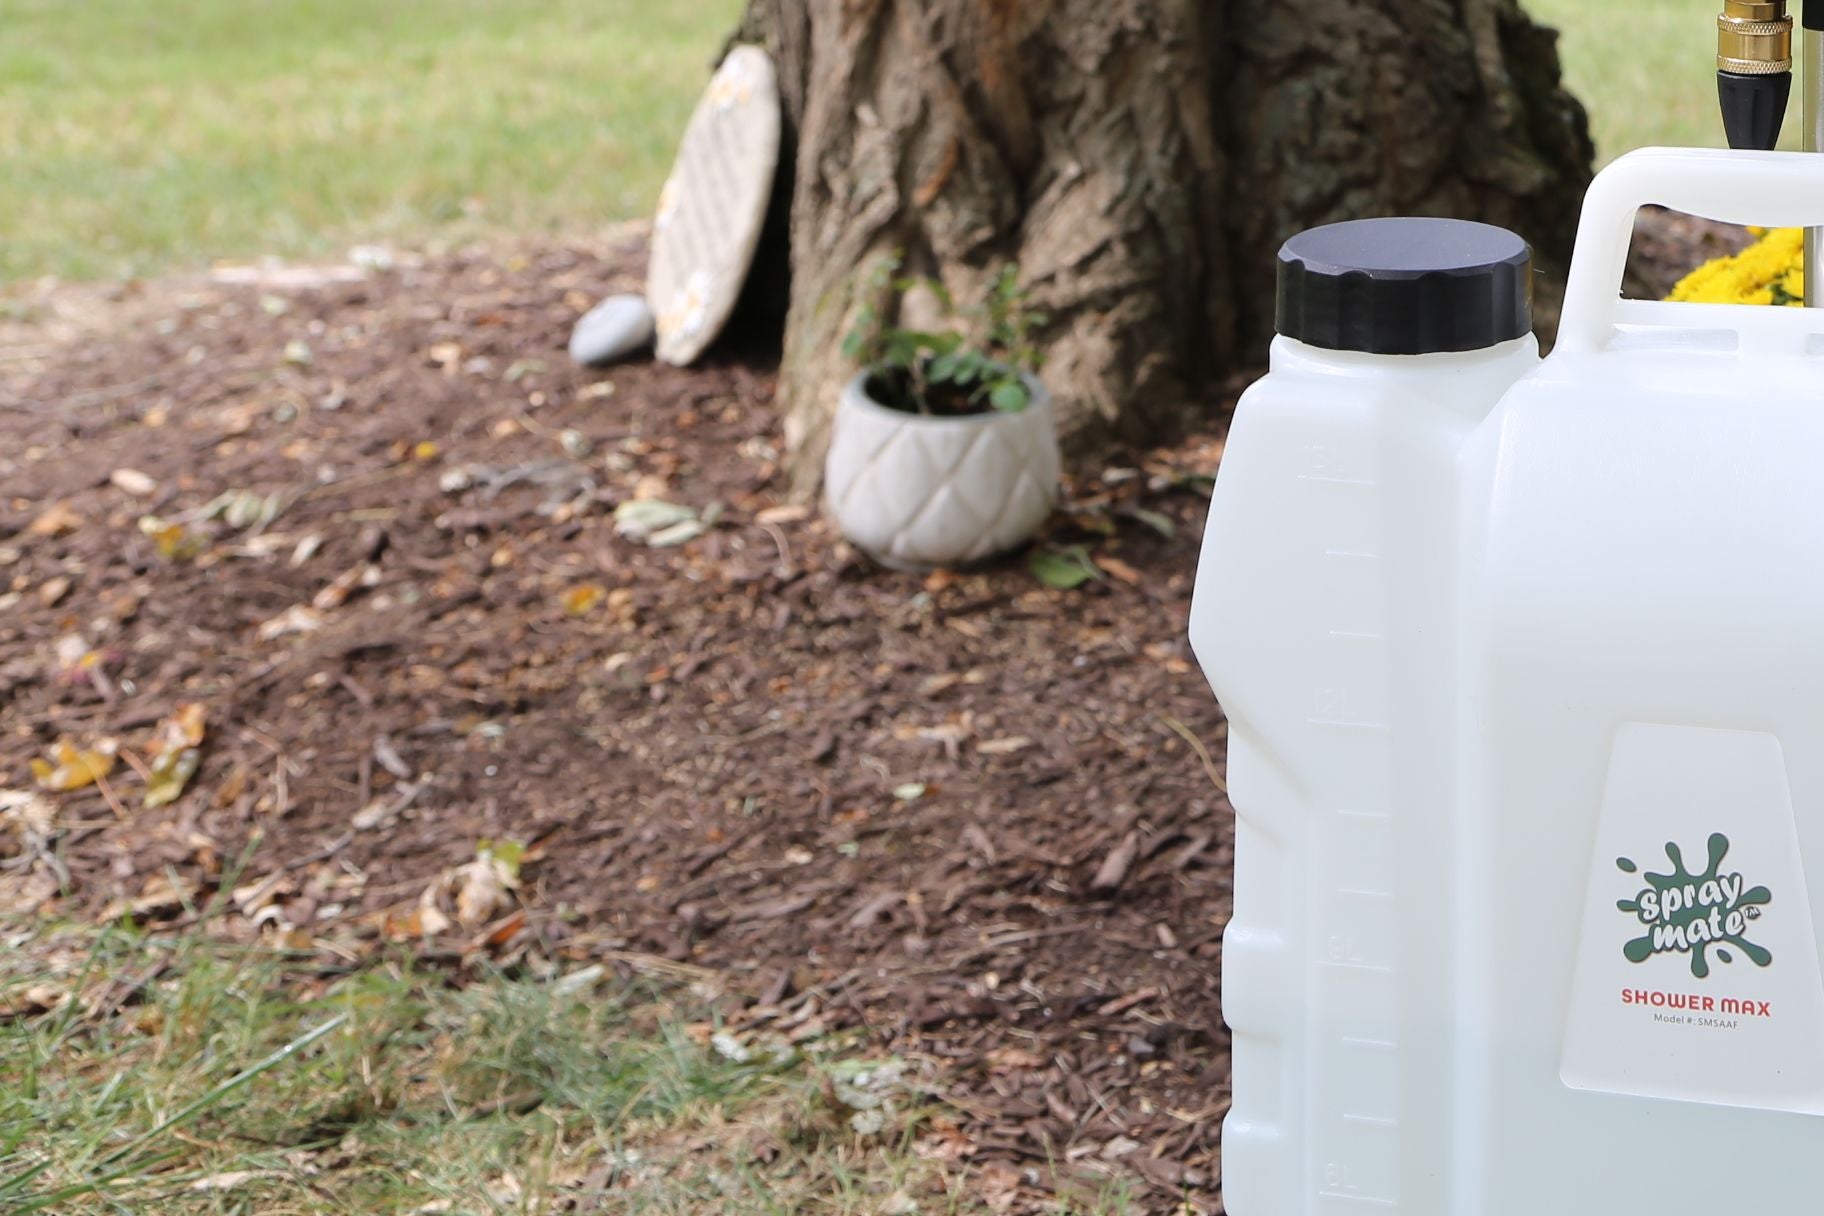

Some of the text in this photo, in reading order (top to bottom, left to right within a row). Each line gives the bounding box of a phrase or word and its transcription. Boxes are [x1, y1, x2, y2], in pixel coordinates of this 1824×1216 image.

[1640, 875, 1742, 921] spray
[1653, 907, 1745, 950] mate
[1621, 988, 1771, 1017] SHOWER MAX
[1653, 1012, 1685, 1025] Model
[1697, 1017, 1739, 1030] SMSAAF
